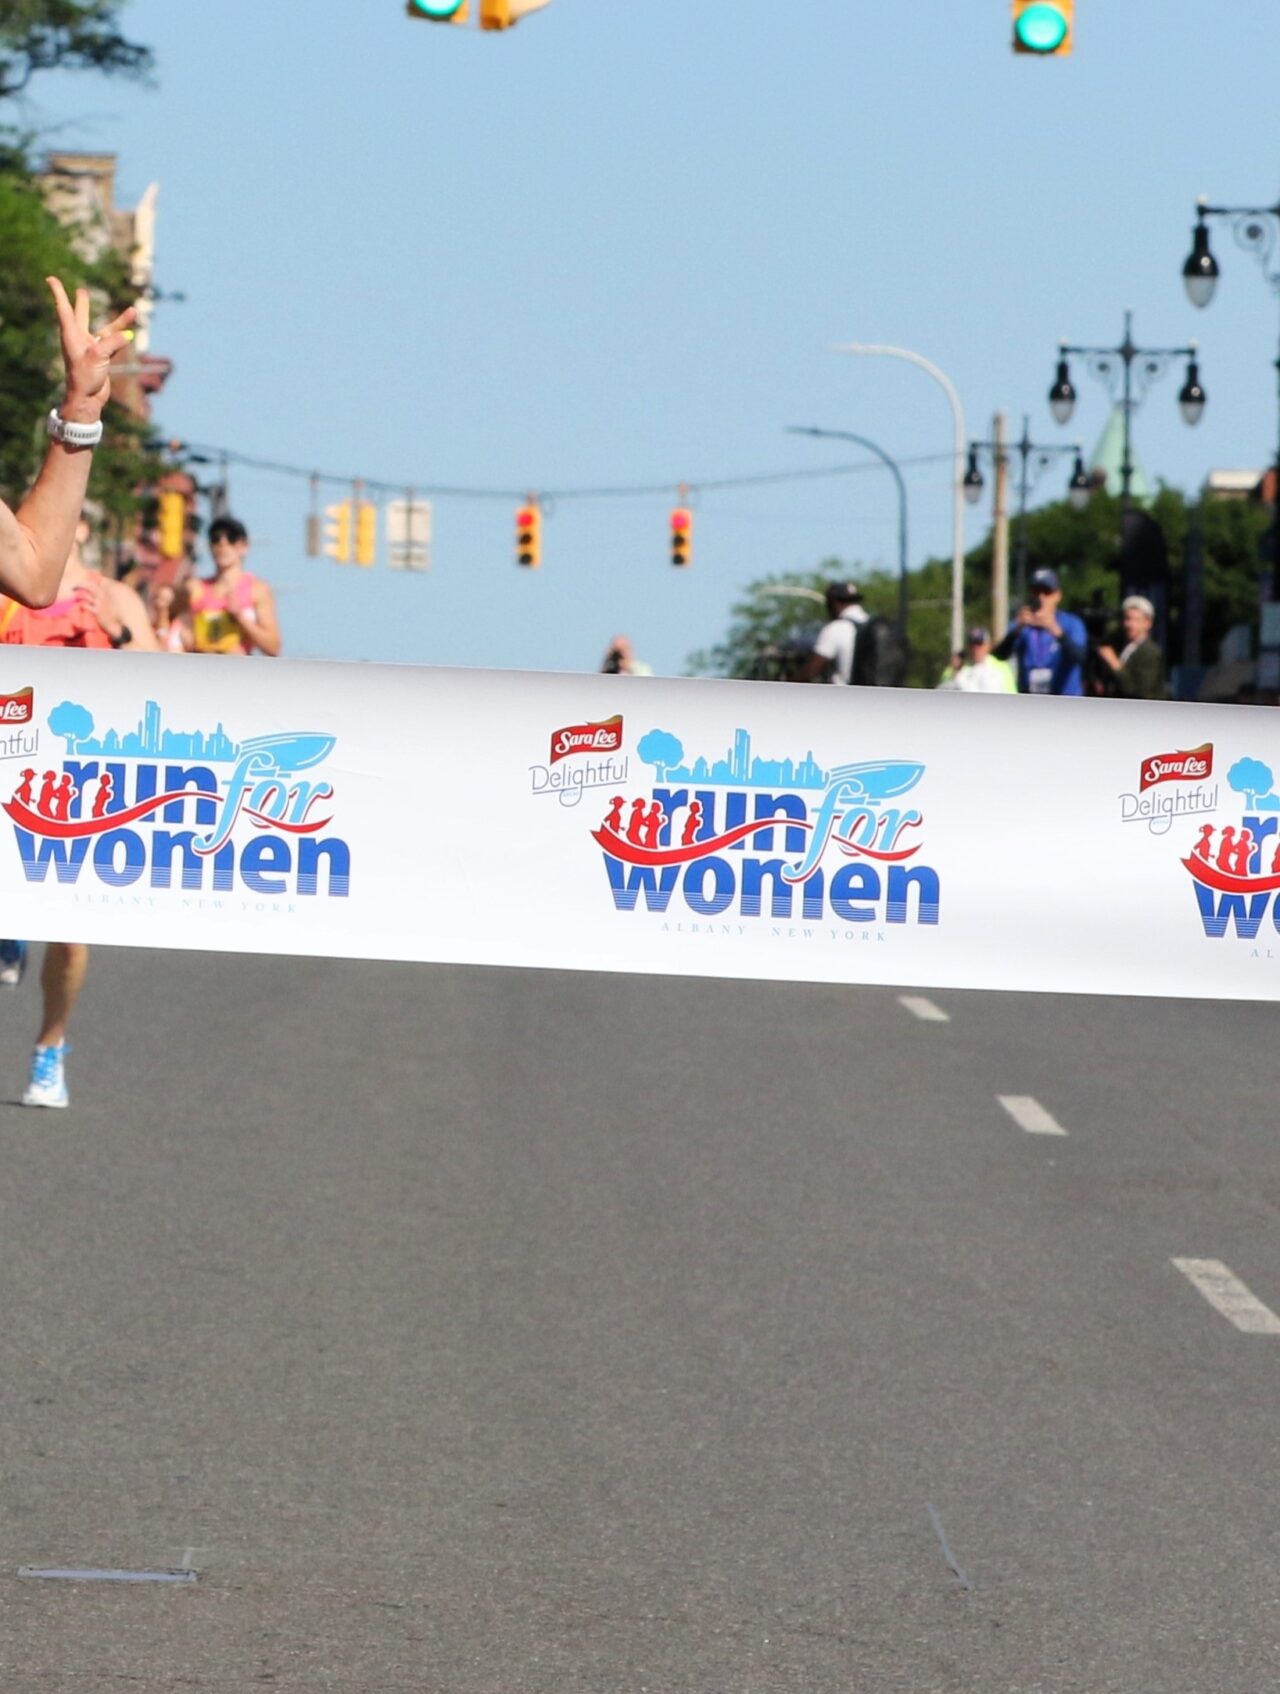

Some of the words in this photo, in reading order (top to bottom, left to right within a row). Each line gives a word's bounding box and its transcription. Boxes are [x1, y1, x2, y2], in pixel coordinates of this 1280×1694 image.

[61, 760, 217, 825] run
[192, 751, 334, 854] for
[528, 756, 627, 806] Delightful
[1118, 784, 1217, 834] Delightful
[12, 823, 351, 898] women
[652, 788, 807, 853] run
[782, 778, 924, 883] for
[602, 852, 941, 925] women
[661, 922, 747, 936] ALBANY
[772, 927, 816, 939] NEW
[830, 929, 887, 942] YORK
